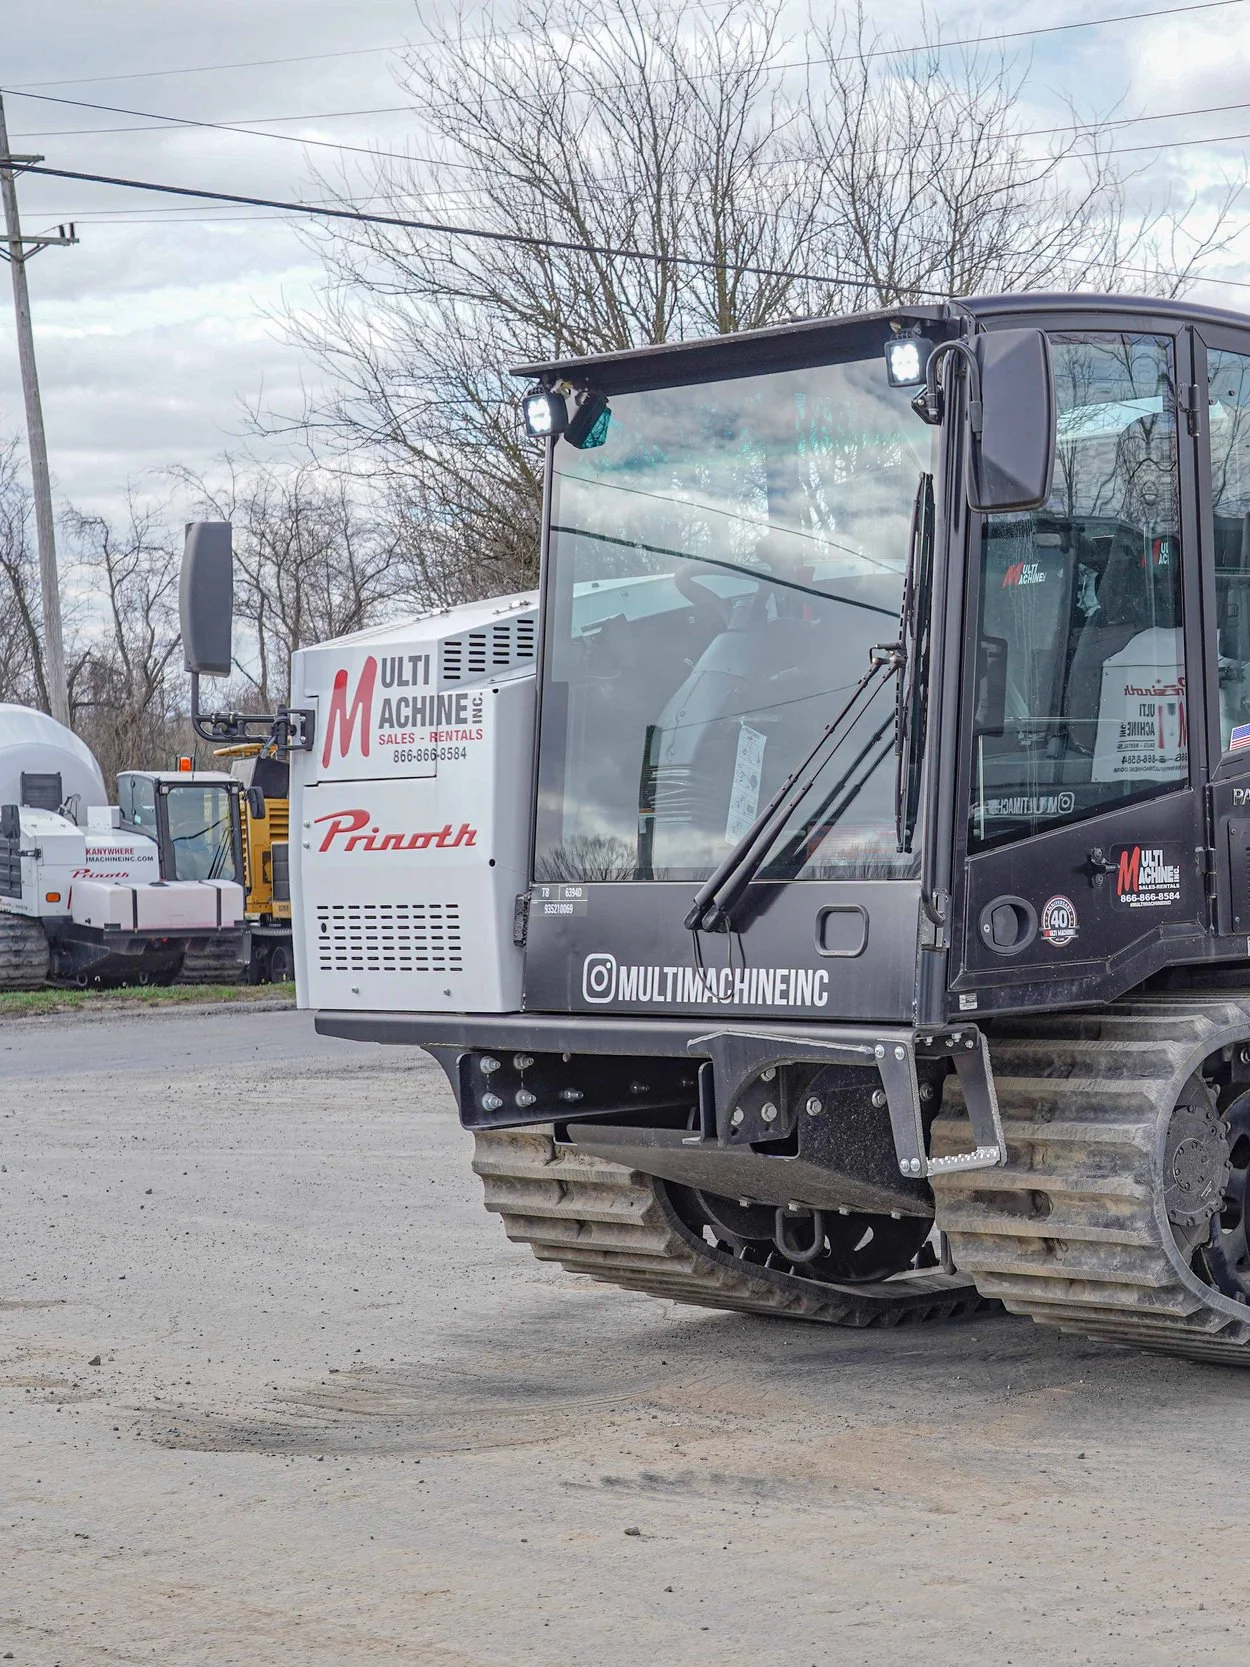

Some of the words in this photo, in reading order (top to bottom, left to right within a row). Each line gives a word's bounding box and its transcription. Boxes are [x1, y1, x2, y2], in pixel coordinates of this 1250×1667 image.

[378, 732, 416, 746] SALES
[429, 728, 484, 743] RENTALS
[314, 809, 477, 852] Prinoth
[541, 887, 550, 898] T8
[1120, 891, 1180, 903] 866-866-8584
[1051, 909, 1068, 928] 40
[618, 966, 829, 1007] MULTIMACHINEINC
